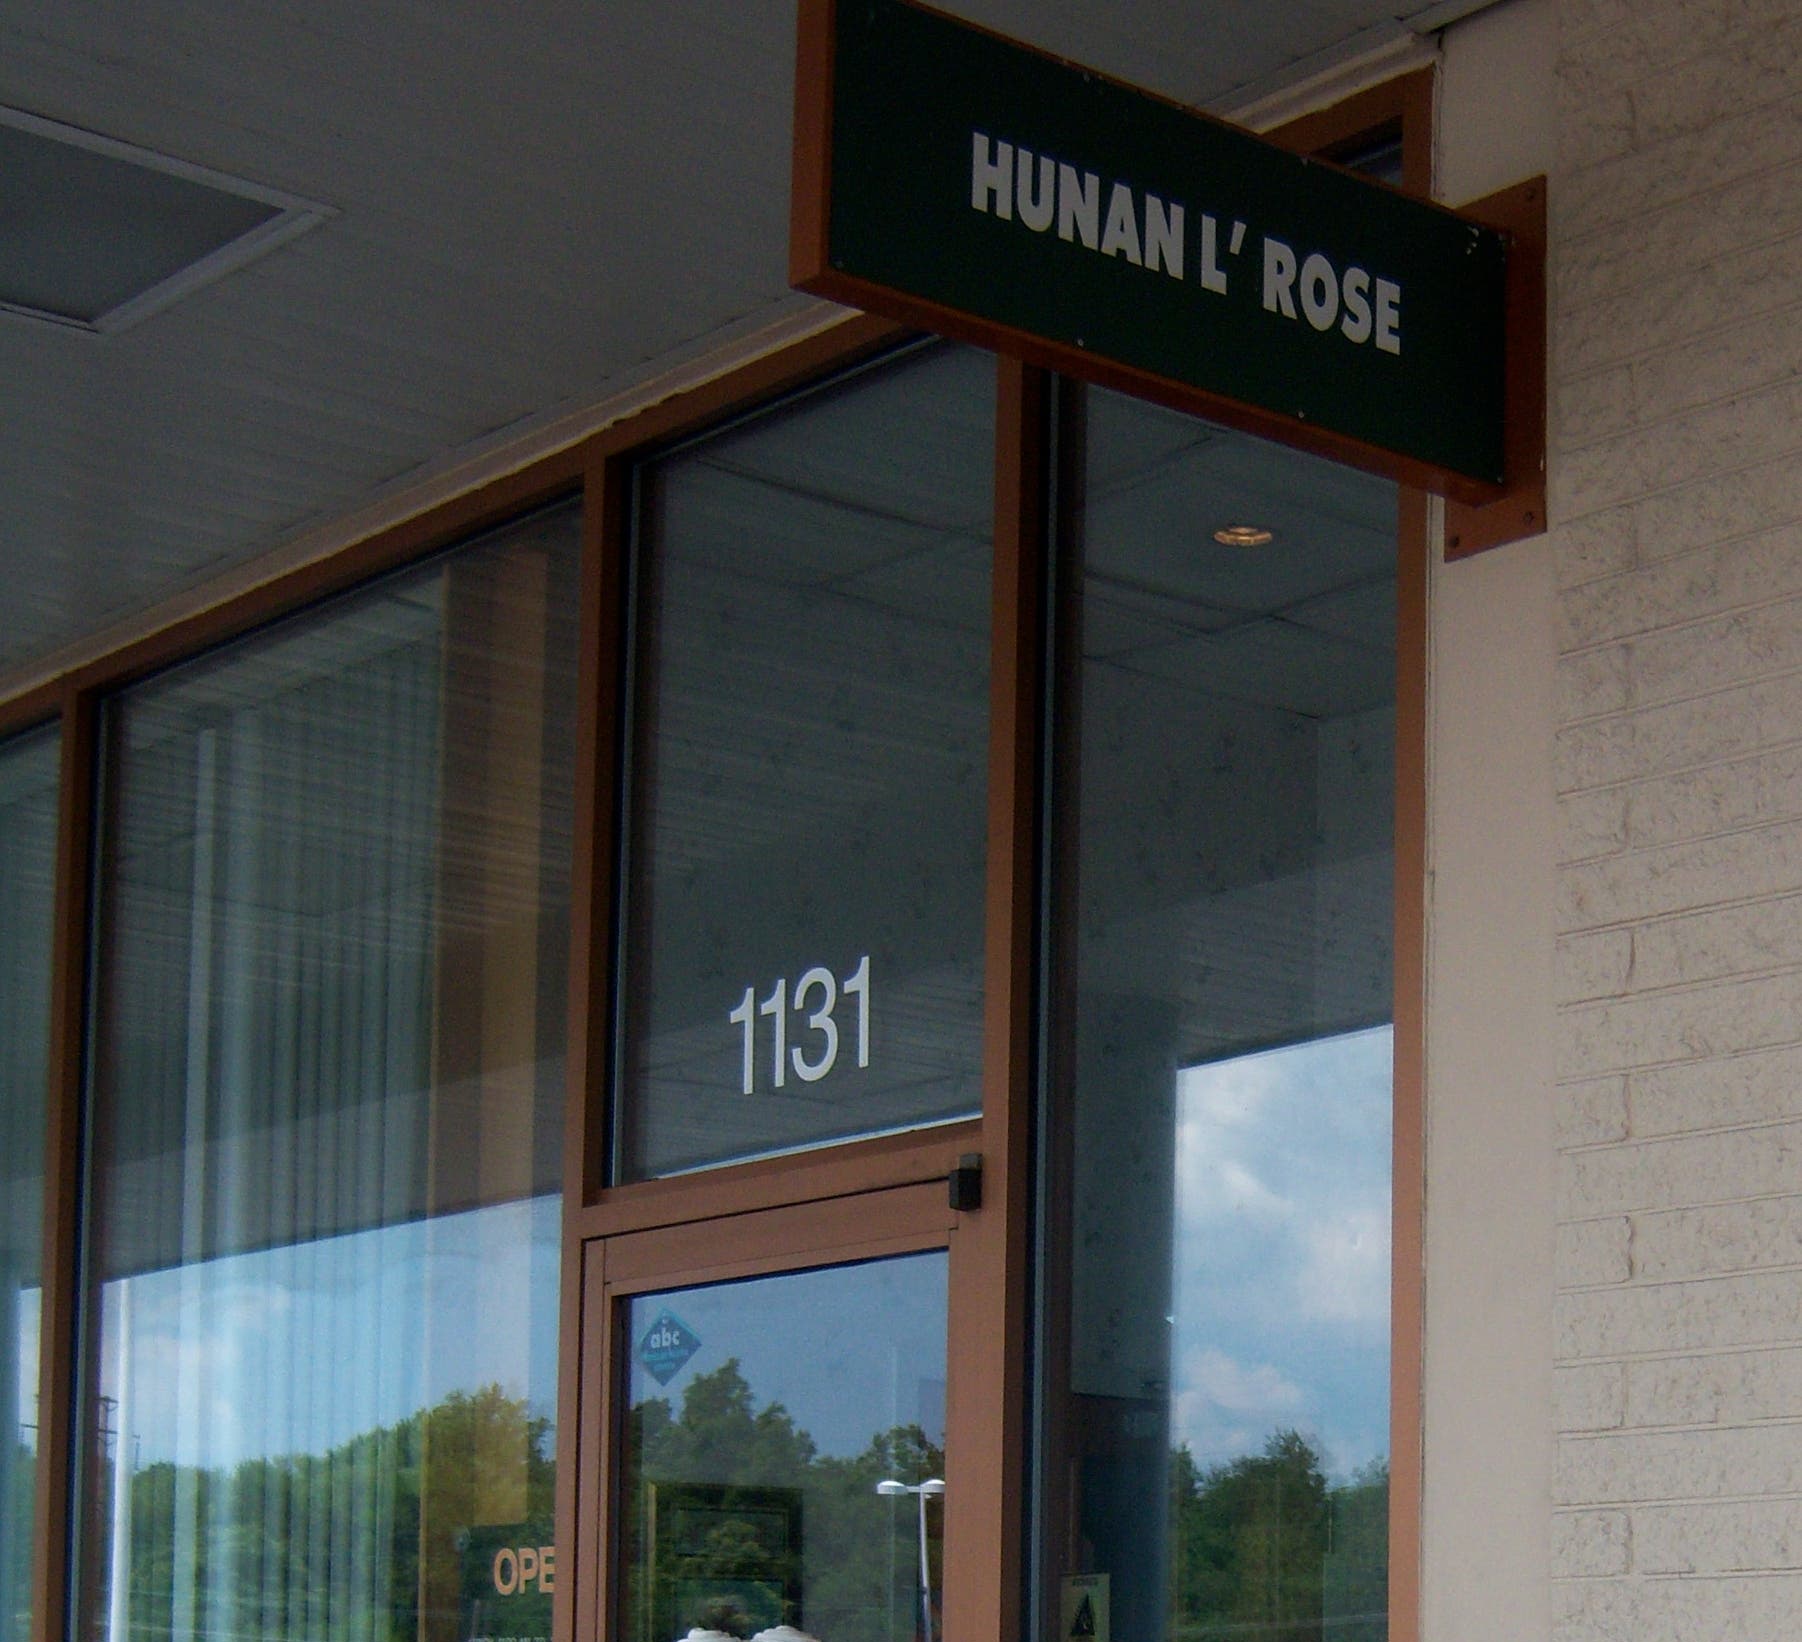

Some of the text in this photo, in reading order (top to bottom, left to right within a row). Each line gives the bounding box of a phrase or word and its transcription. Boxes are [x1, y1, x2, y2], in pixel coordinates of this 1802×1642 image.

[971, 131, 1402, 356] HUNAN L' ROSE
[729, 955, 870, 1095] 1131
[650, 1327, 681, 1349] abc
